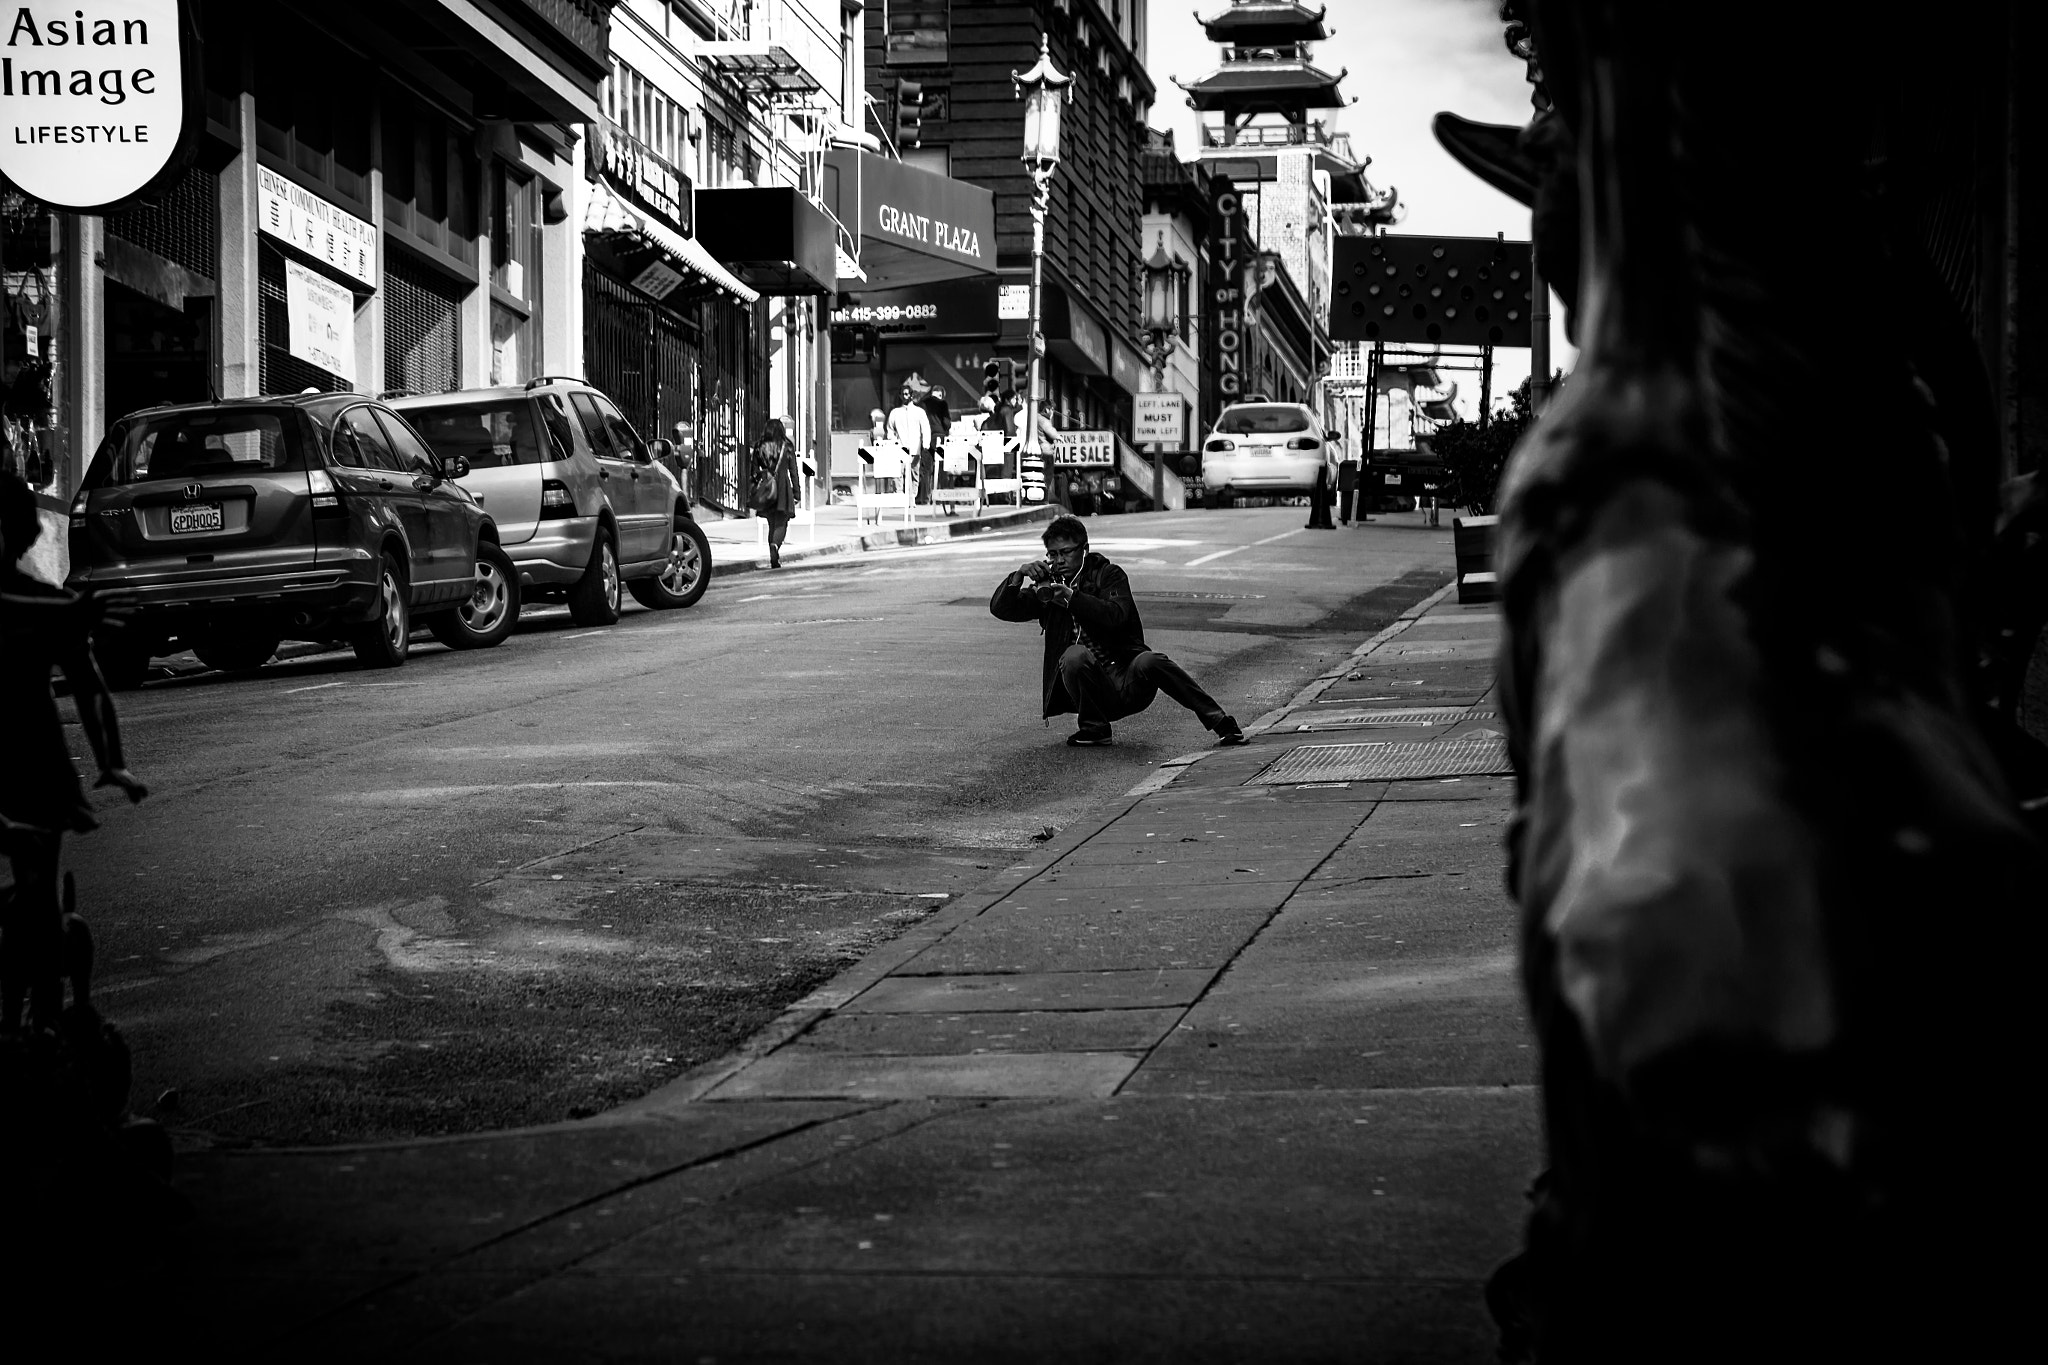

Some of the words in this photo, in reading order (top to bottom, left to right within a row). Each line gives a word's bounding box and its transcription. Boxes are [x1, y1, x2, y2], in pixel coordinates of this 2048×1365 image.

[7, 8, 148, 46] Asian
[2, 58, 155, 105] Image
[15, 125, 149, 144] LIFESTYLE
[259, 168, 288, 201] CHINESE
[290, 185, 329, 223] COMMUNITY
[332, 209, 357, 239] HEALTH
[359, 223, 375, 247] PLAN
[880, 204, 929, 243] GRANT
[935, 220, 980, 258] PLAZA
[1217, 193, 1237, 281] CITY
[1216, 288, 1239, 303] OF
[851, 304, 937, 322] 415-399-0882
[1219, 309, 1239, 395] HONG
[1139, 400, 1156, 408] LEFT
[1161, 400, 1180, 408] LANE
[1144, 413, 1172, 422] MUST
[1080, 445, 1110, 463] SALE
[173, 512, 220, 530] 6PDH005
